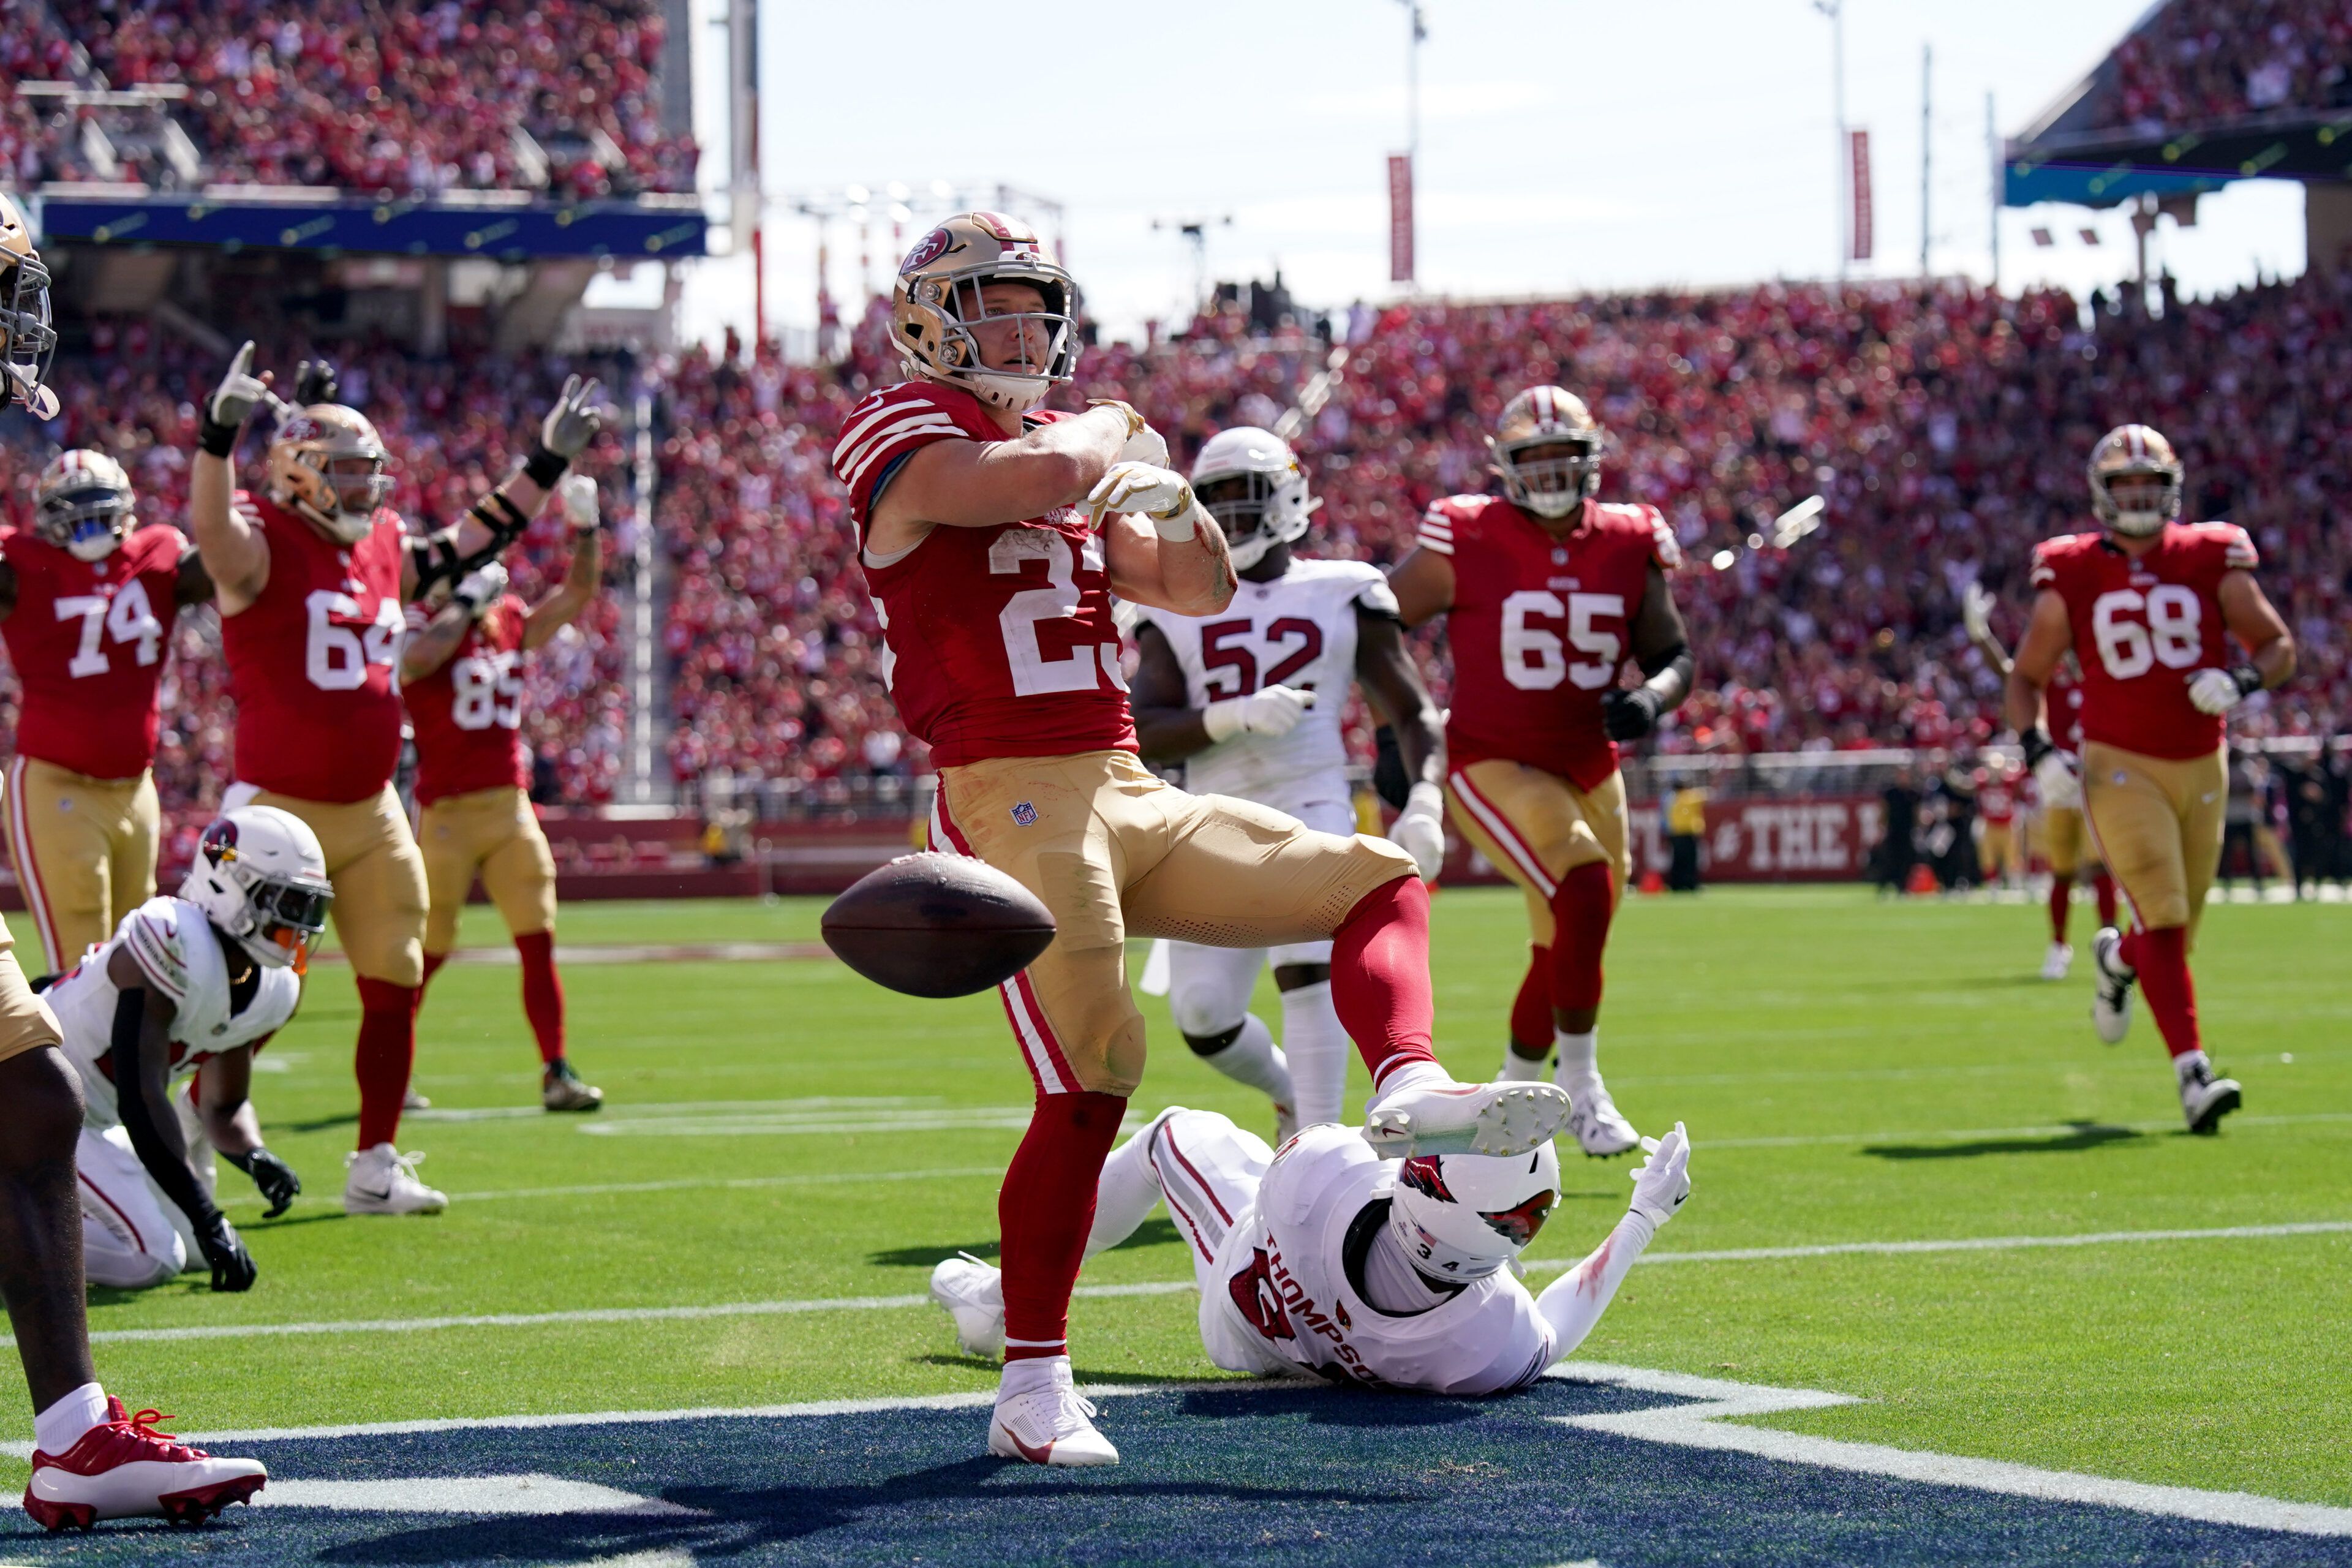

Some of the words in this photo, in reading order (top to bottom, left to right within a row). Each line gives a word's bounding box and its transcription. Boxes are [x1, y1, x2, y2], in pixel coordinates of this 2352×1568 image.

[54, 576, 164, 679] 74
[305, 589, 407, 696] 64
[1200, 617, 1323, 709] 52
[1500, 590, 1625, 690] 65
[2092, 584, 2203, 680] 68
[451, 649, 525, 730] 85
[1017, 810, 1035, 823] NFL
[1743, 803, 1849, 872] THE
[1266, 1226, 1385, 1387] THOMPSO
